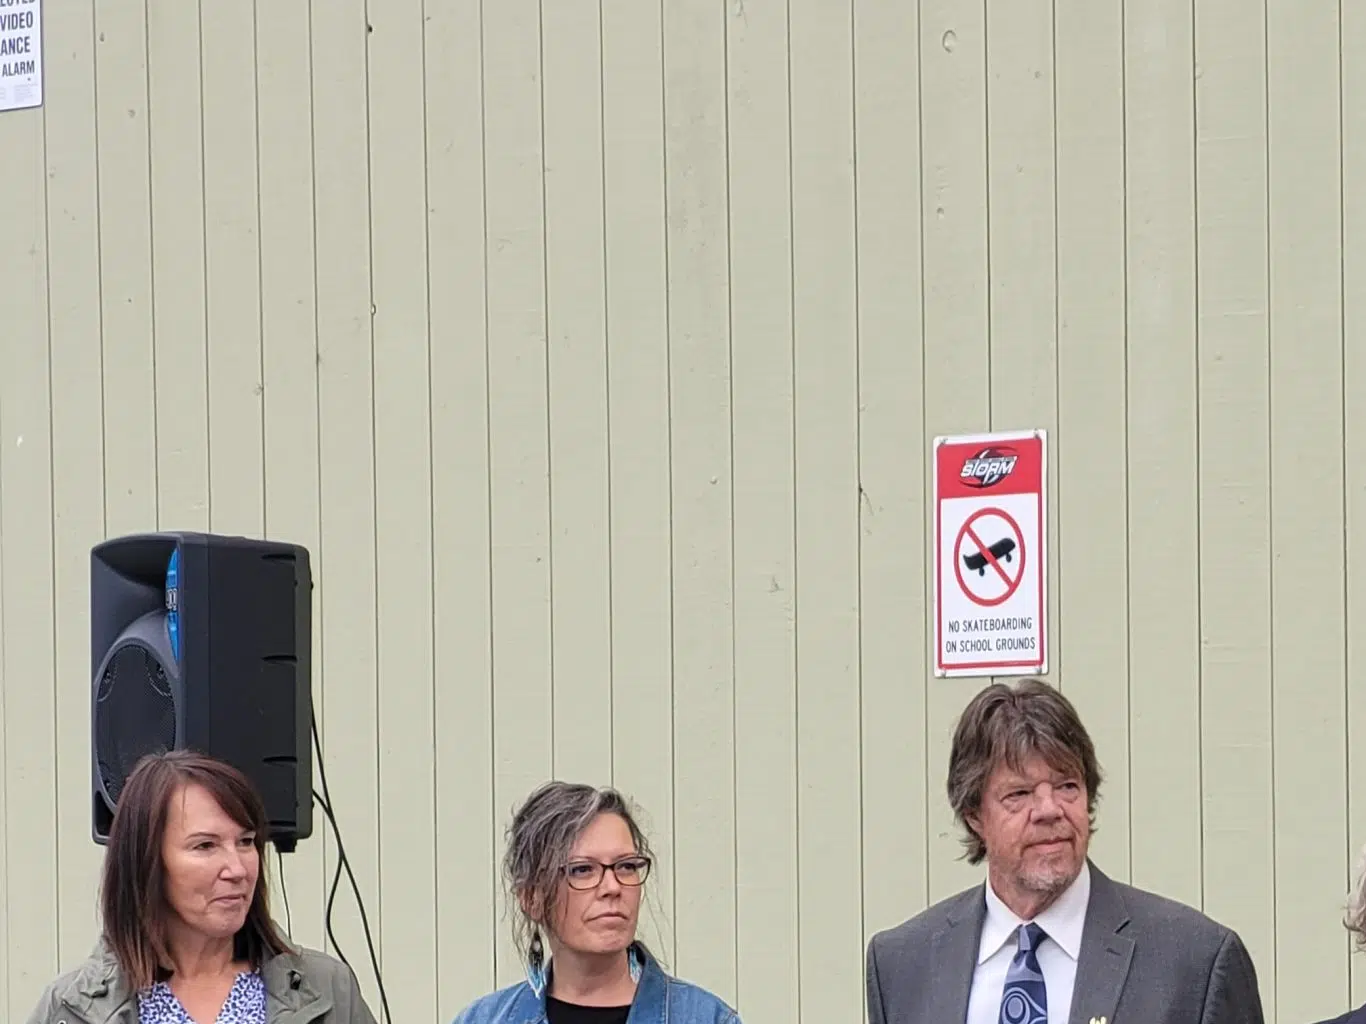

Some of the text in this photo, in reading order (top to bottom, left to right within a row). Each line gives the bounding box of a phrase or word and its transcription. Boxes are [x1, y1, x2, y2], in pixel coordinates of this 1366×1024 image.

[0, 10, 34, 31] VIDEO
[2, 60, 35, 77] ALARM
[948, 616, 1033, 633] NO SKATEBOARDING
[945, 636, 1036, 653] ON SCHOOL GROUNDS
